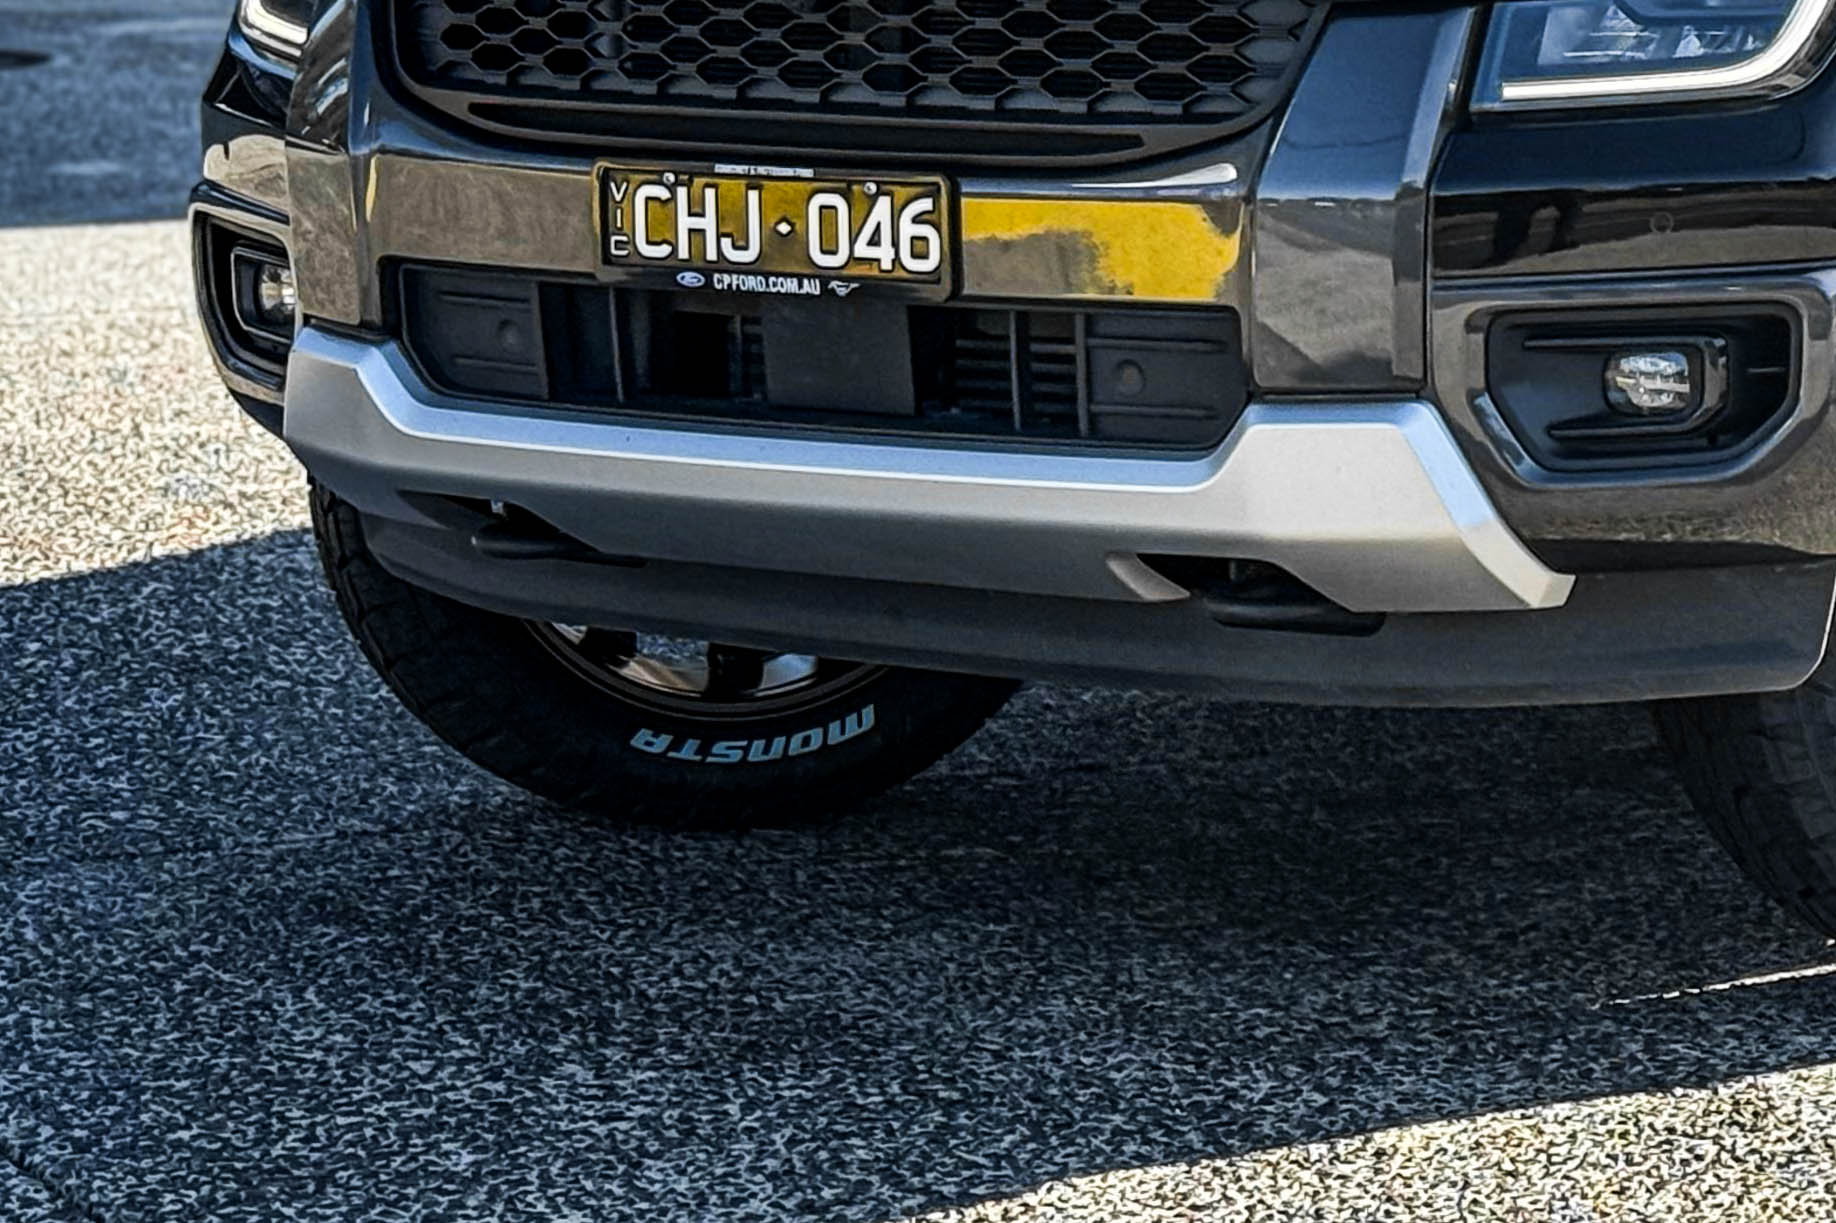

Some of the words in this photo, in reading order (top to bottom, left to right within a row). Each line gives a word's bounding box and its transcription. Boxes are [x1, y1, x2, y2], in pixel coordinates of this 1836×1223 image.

[610, 180, 631, 257] VIC
[633, 184, 762, 265] CHJ
[807, 192, 942, 273] 046
[712, 272, 821, 296] CPFORD.COM.AU
